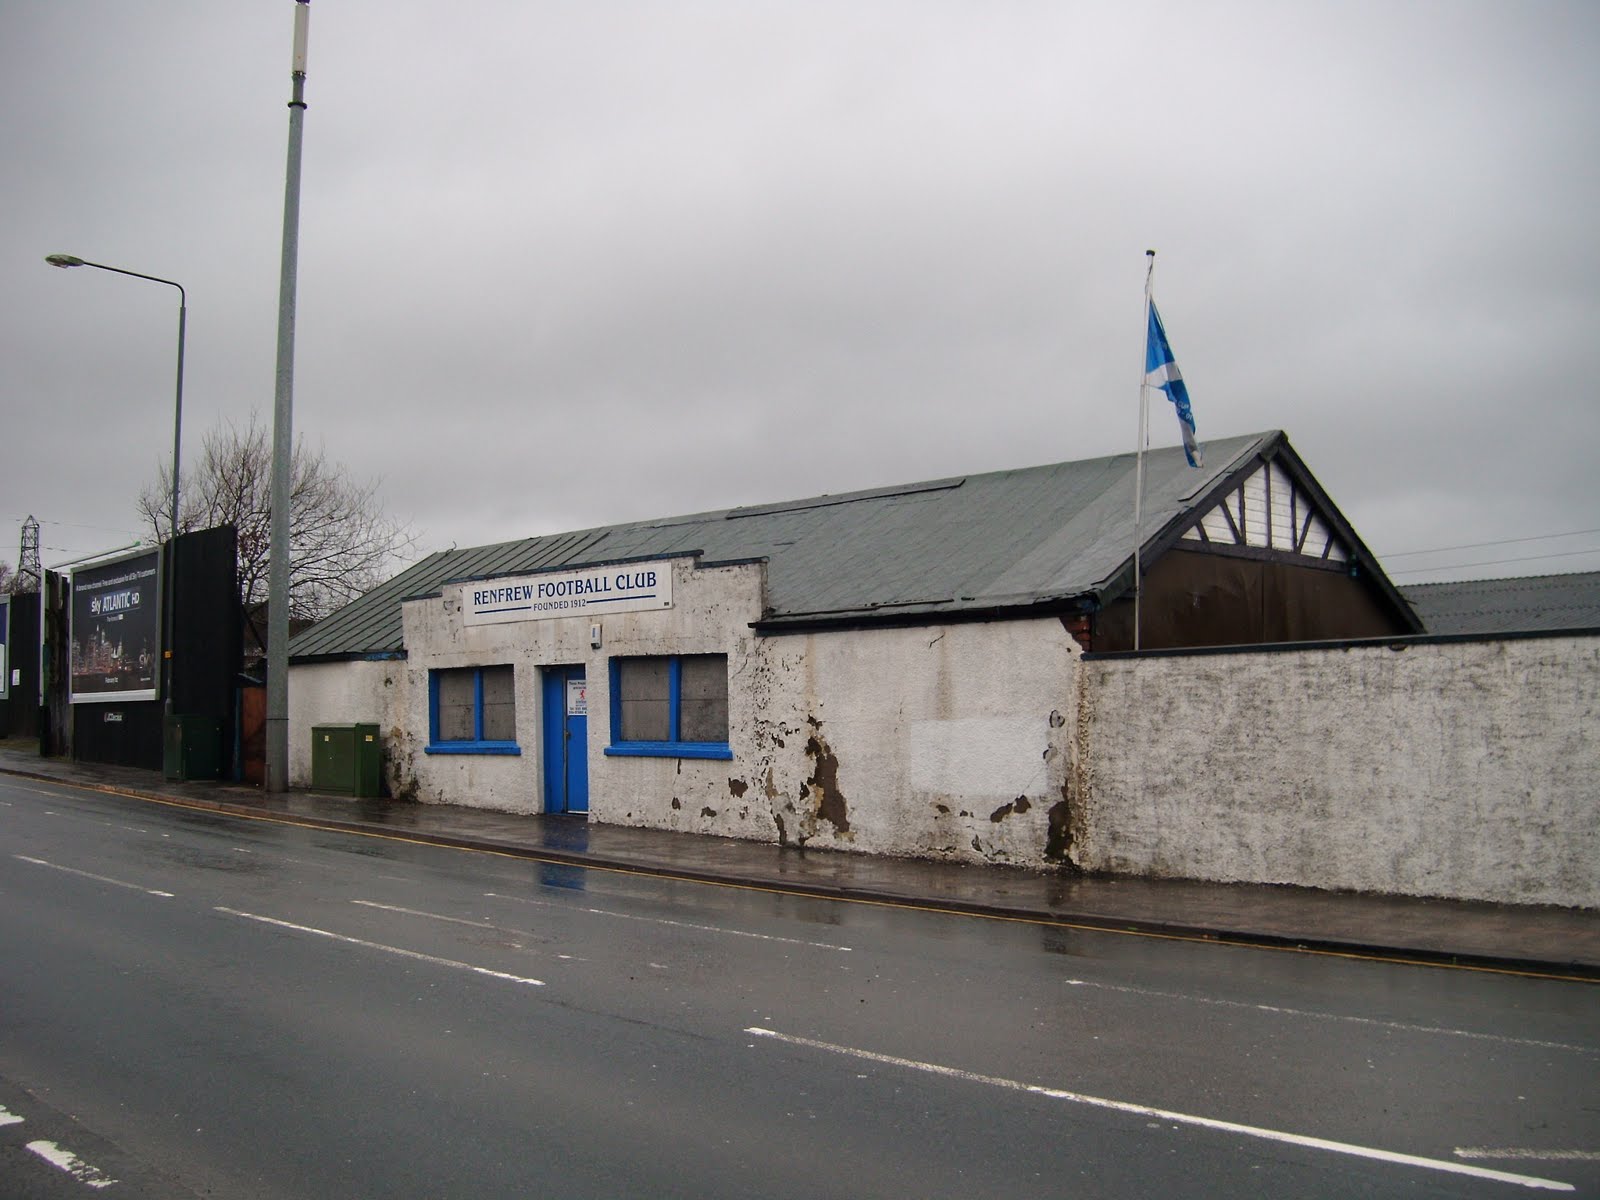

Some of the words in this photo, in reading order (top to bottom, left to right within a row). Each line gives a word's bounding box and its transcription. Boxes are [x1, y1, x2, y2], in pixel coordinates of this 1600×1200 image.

[474, 585, 533, 605] RENFREW
[538, 576, 611, 598] FOOTBALL
[616, 571, 656, 590] CLUB
[91, 597, 101, 615] sky
[103, 592, 130, 612] ATLANTIC
[131, 592, 140, 605] HD
[534, 601, 569, 611] FOUNDED
[571, 599, 586, 608] 1912
